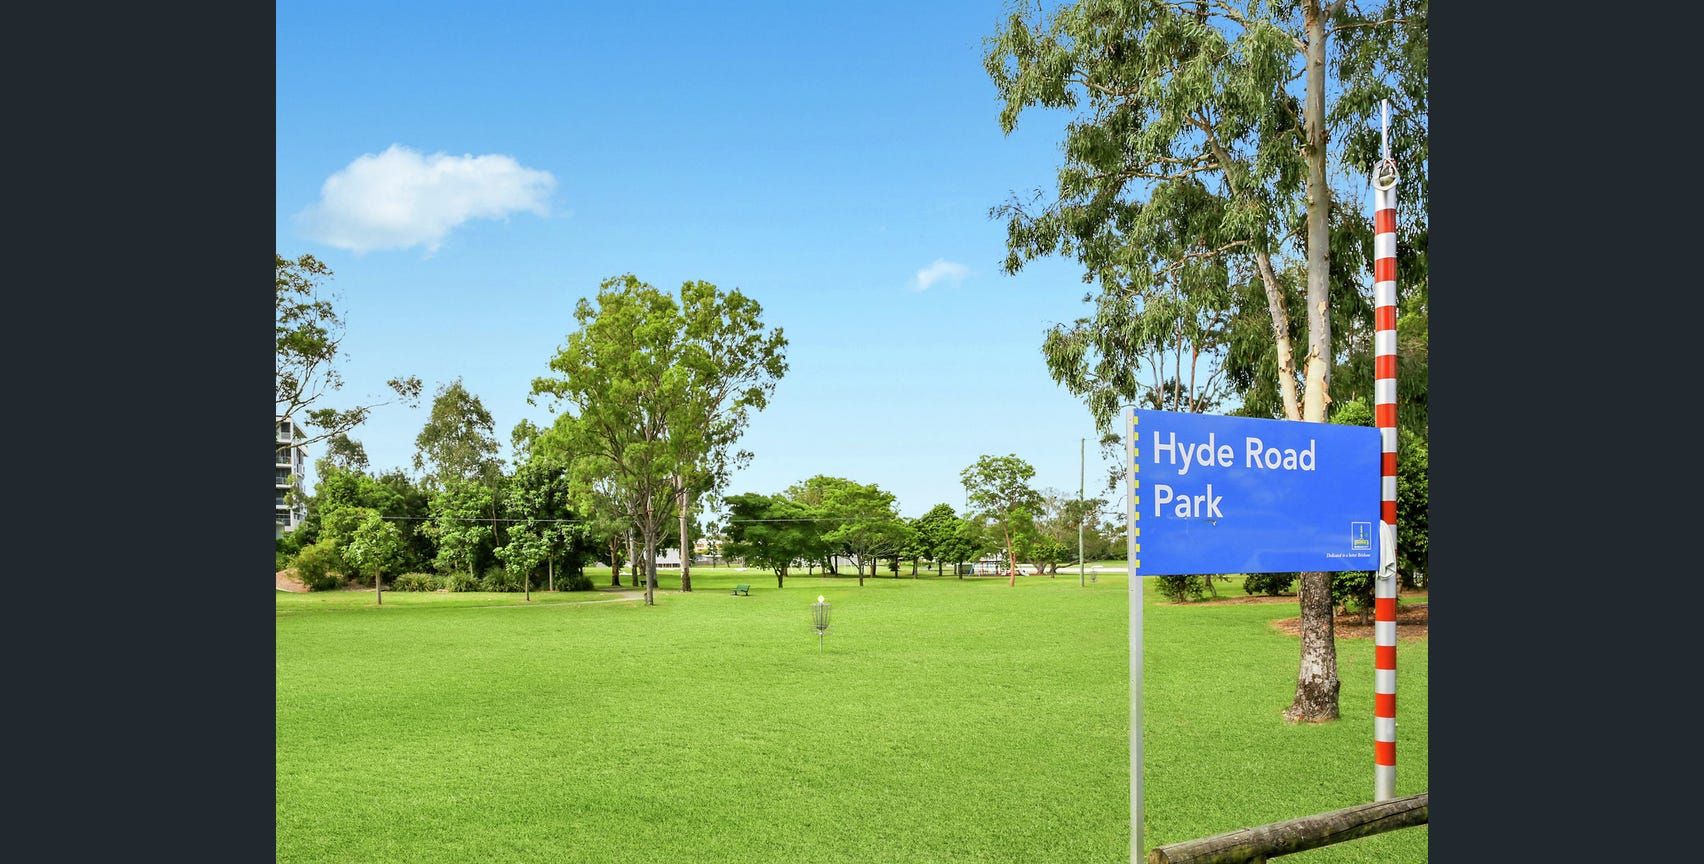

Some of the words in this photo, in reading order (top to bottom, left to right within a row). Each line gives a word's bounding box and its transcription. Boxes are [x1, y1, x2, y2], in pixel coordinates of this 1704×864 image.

[1153, 431, 1234, 475] Hyde
[1246, 437, 1316, 471] Road
[1154, 484, 1223, 518] Park
